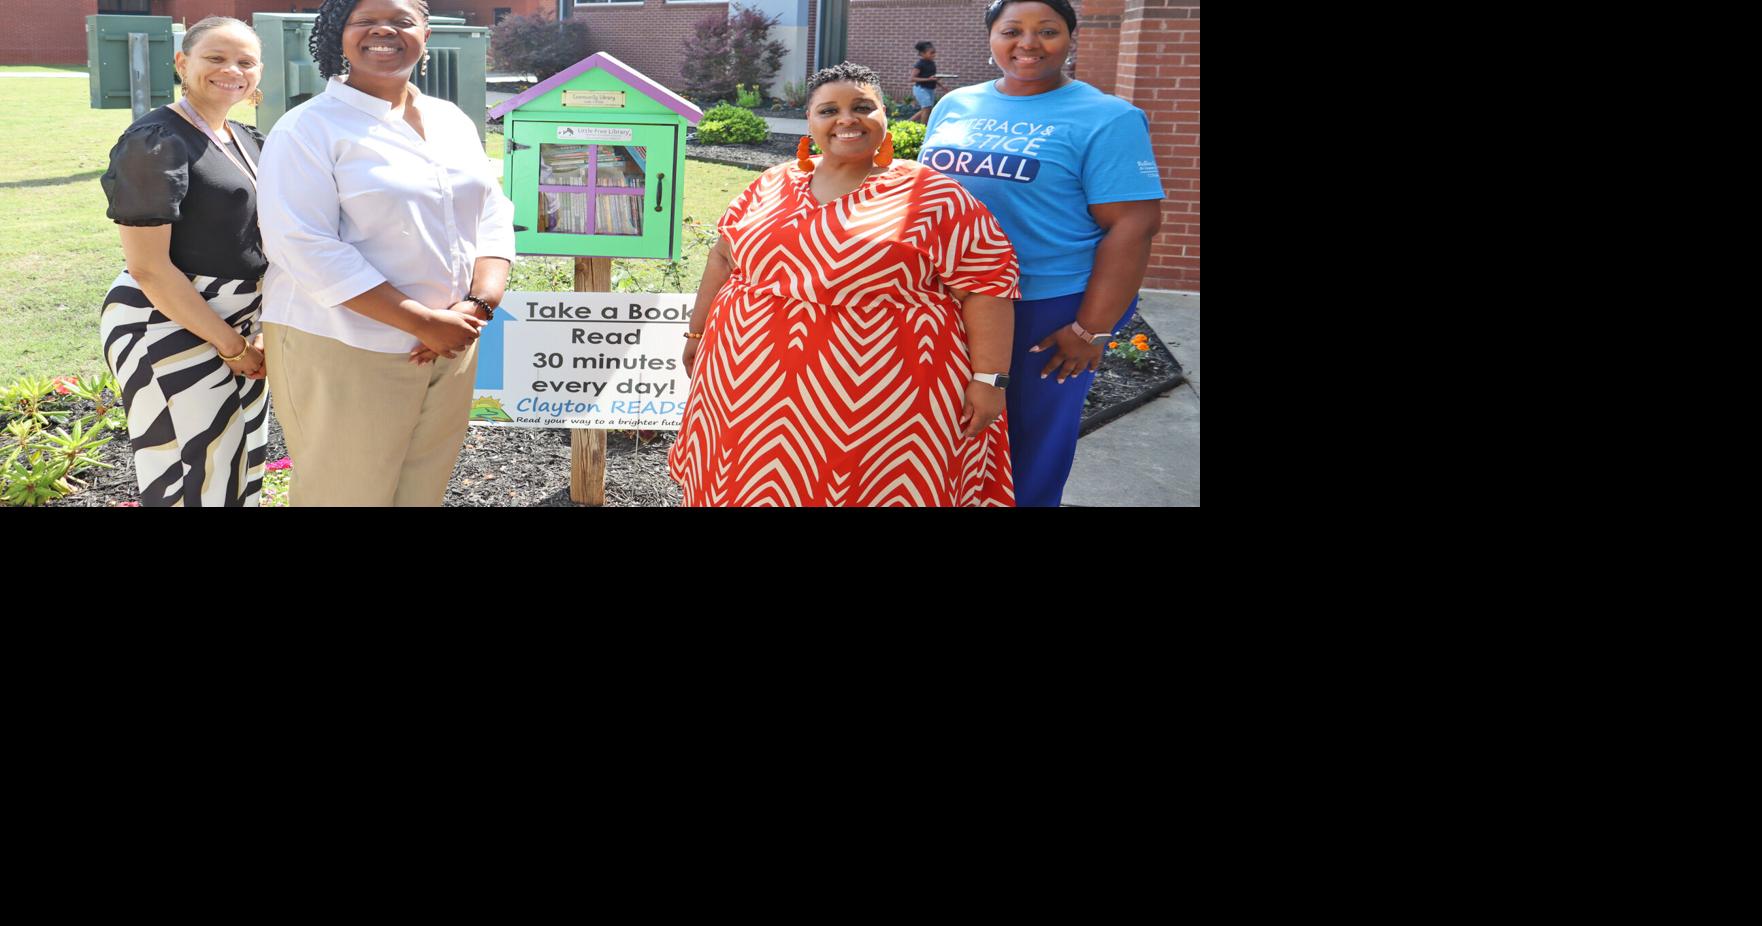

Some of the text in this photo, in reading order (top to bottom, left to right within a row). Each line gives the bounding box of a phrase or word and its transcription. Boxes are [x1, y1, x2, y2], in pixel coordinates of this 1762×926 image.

[962, 117, 1056, 137] TERACY&
[957, 133, 1047, 157] STICE
[921, 148, 1031, 182] FOR ALL
[526, 301, 694, 321] Take a Book
[571, 328, 641, 345] Read
[532, 352, 677, 370] 30 minutes
[531, 378, 675, 398] every day!
[516, 396, 687, 417] Clayton READS
[516, 416, 541, 424] Read
[544, 418, 567, 426] your
[571, 418, 591, 426] way
[595, 417, 605, 425] to
[618, 417, 659, 427] brighter
[661, 418, 682, 427] futu
